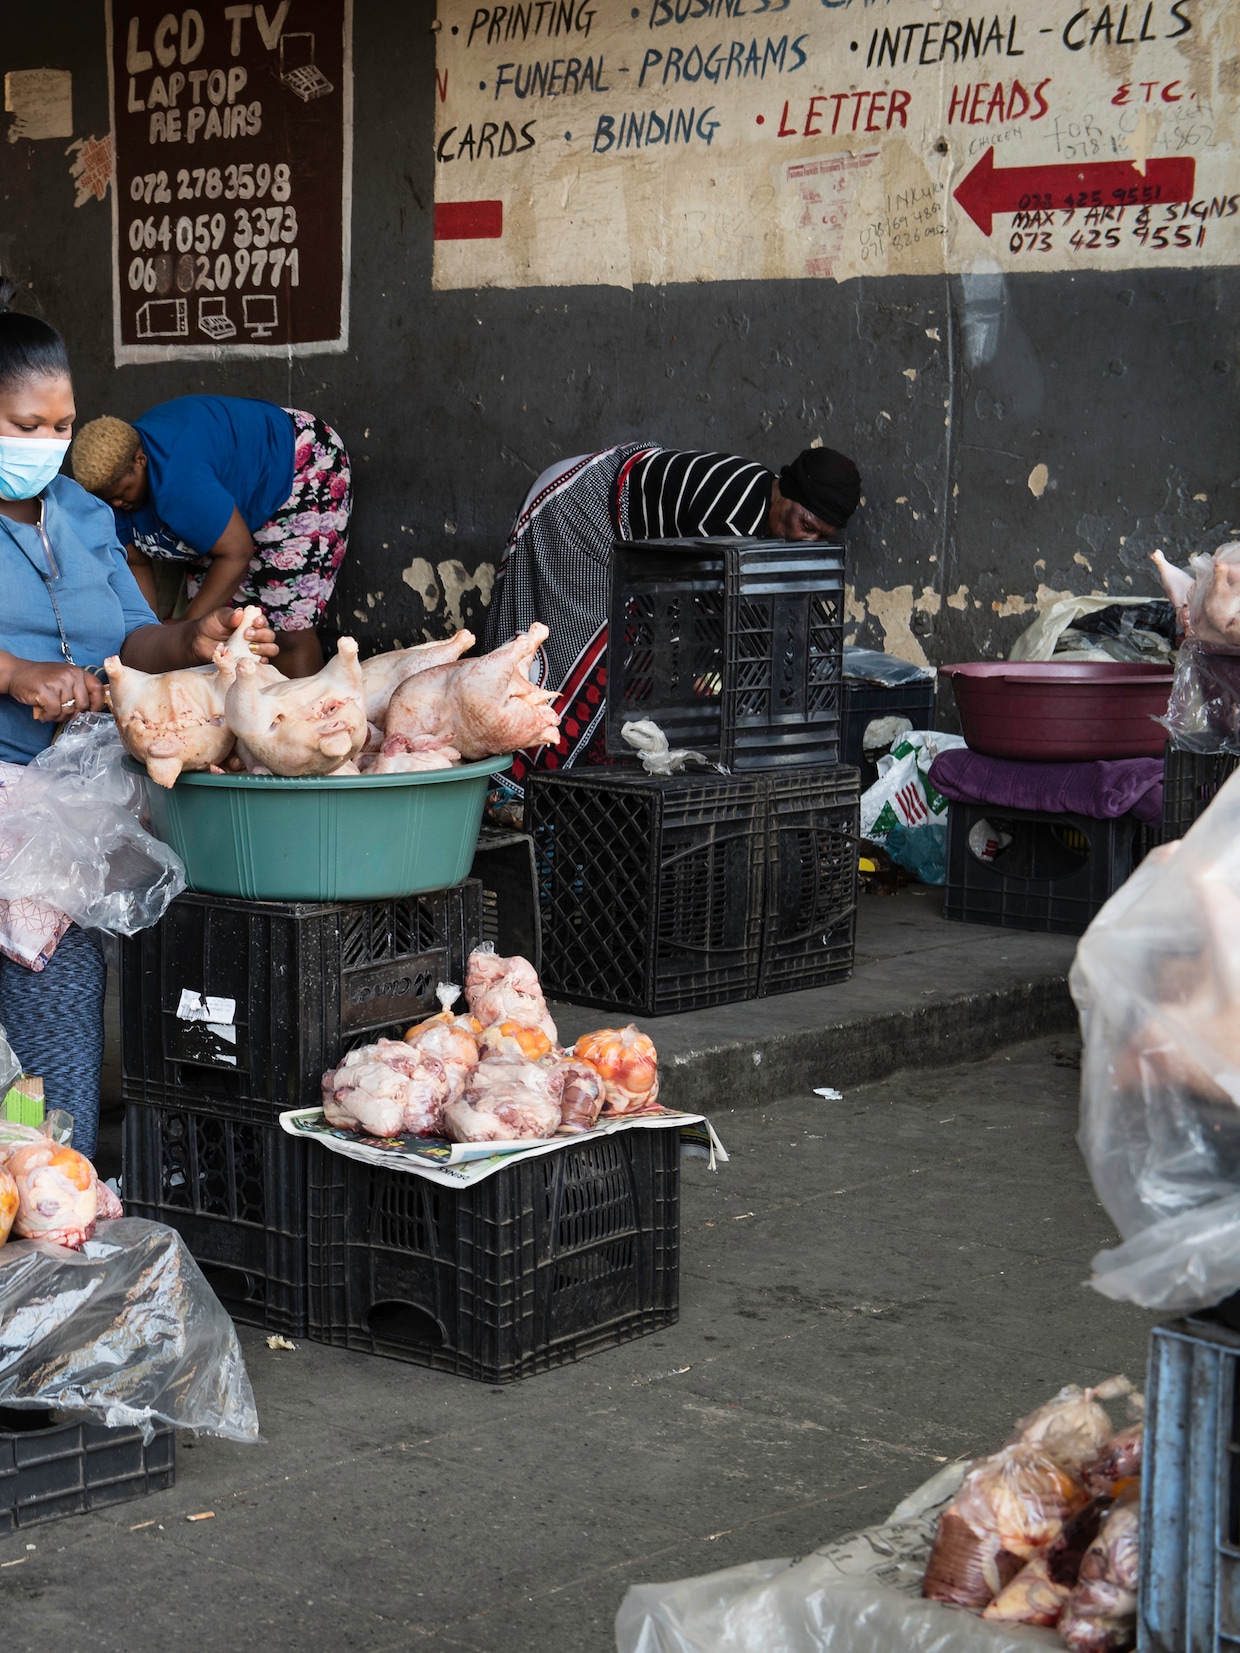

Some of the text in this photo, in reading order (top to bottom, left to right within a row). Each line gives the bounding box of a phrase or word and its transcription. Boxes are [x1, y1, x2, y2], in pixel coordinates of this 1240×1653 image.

[126, 1, 291, 75] LCD TV
[467, 0, 597, 48] PRINTING
[866, 14, 1024, 68] INTERNAL
[1063, 0, 1193, 51] CALLS
[127, 66, 248, 113] LAPTOP
[495, 55, 609, 100] FUNERAL
[638, 34, 809, 88] PROGRAMS
[777, 89, 912, 137] LETTER
[948, 78, 1052, 125] HEADS
[437, 106, 721, 163] CARDS BINDING
[968, 127, 1023, 156] CHICKEN
[130, 170, 171, 204] 072
[1112, 186, 1161, 205] 9551
[233, 205, 299, 249] 3373
[1012, 210, 1055, 229] MAX
[1084, 206, 1127, 226] ART
[1163, 195, 1240, 223] SIGNS
[1010, 223, 1206, 254] 073 425 9551
[438, 1166, 471, 1181] DRINKS
